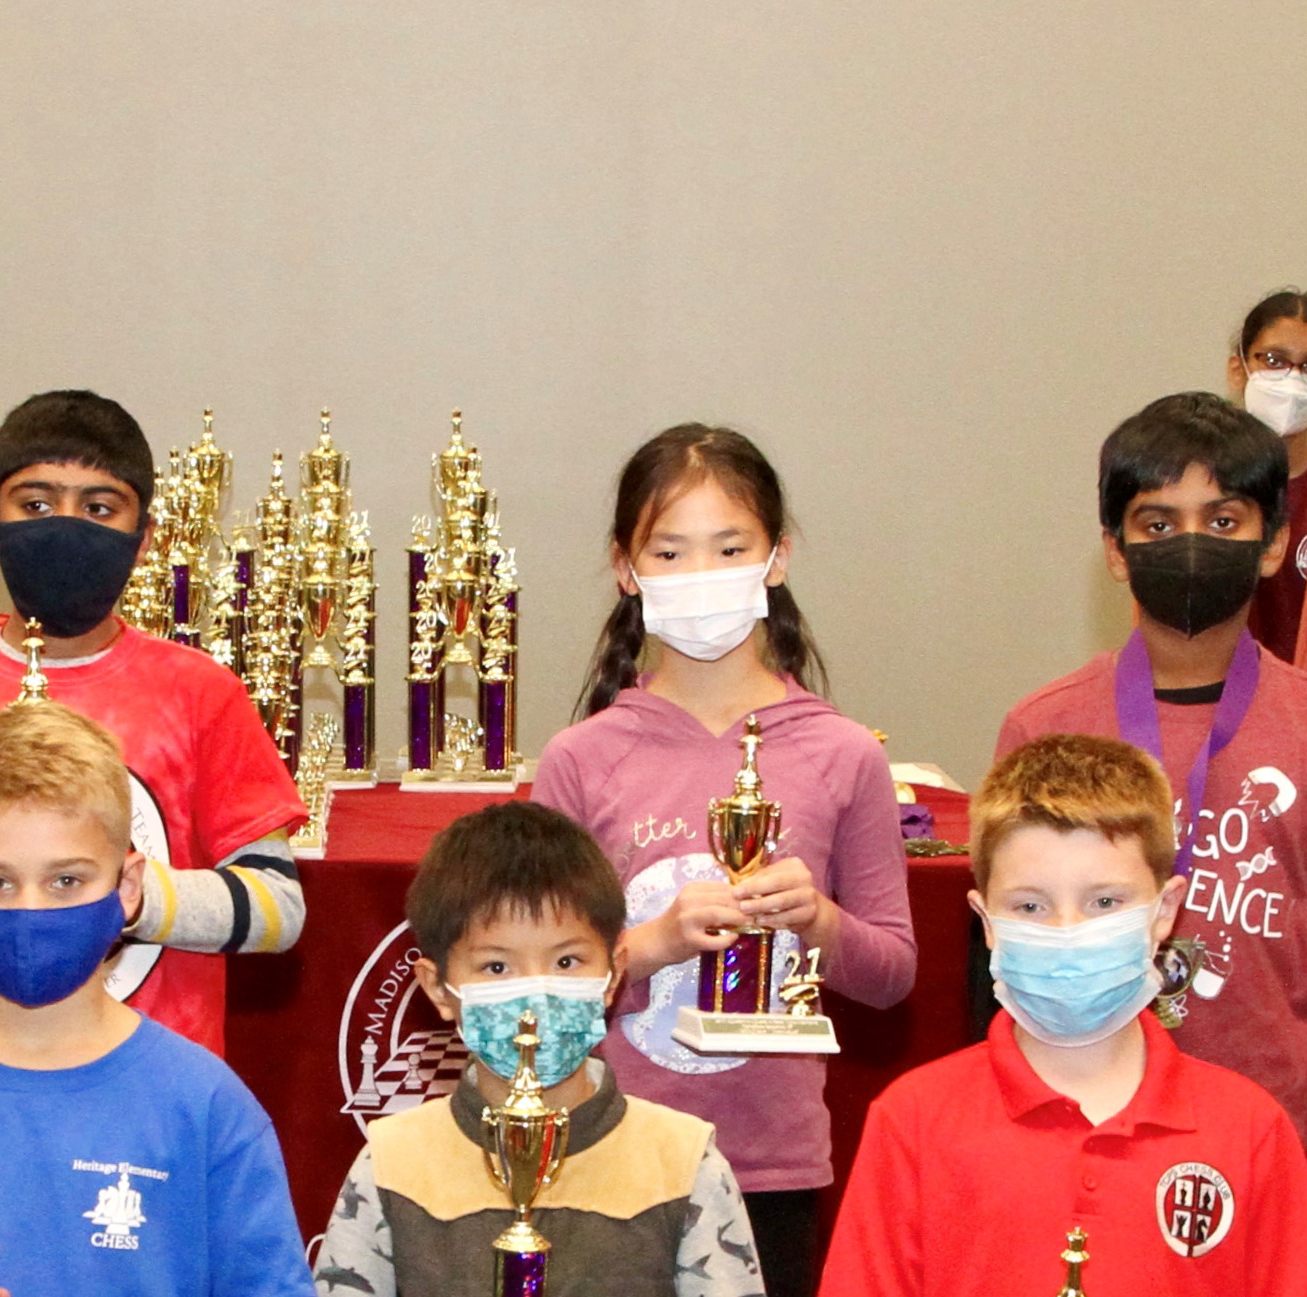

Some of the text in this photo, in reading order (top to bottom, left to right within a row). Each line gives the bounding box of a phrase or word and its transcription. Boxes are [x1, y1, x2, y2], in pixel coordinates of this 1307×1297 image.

[415, 610, 437, 634] 20
[411, 641, 433, 663] 20
[783, 947, 823, 983] 21
[73, 1159, 117, 1175] Heritage
[90, 1232, 139, 1250] CHESS
